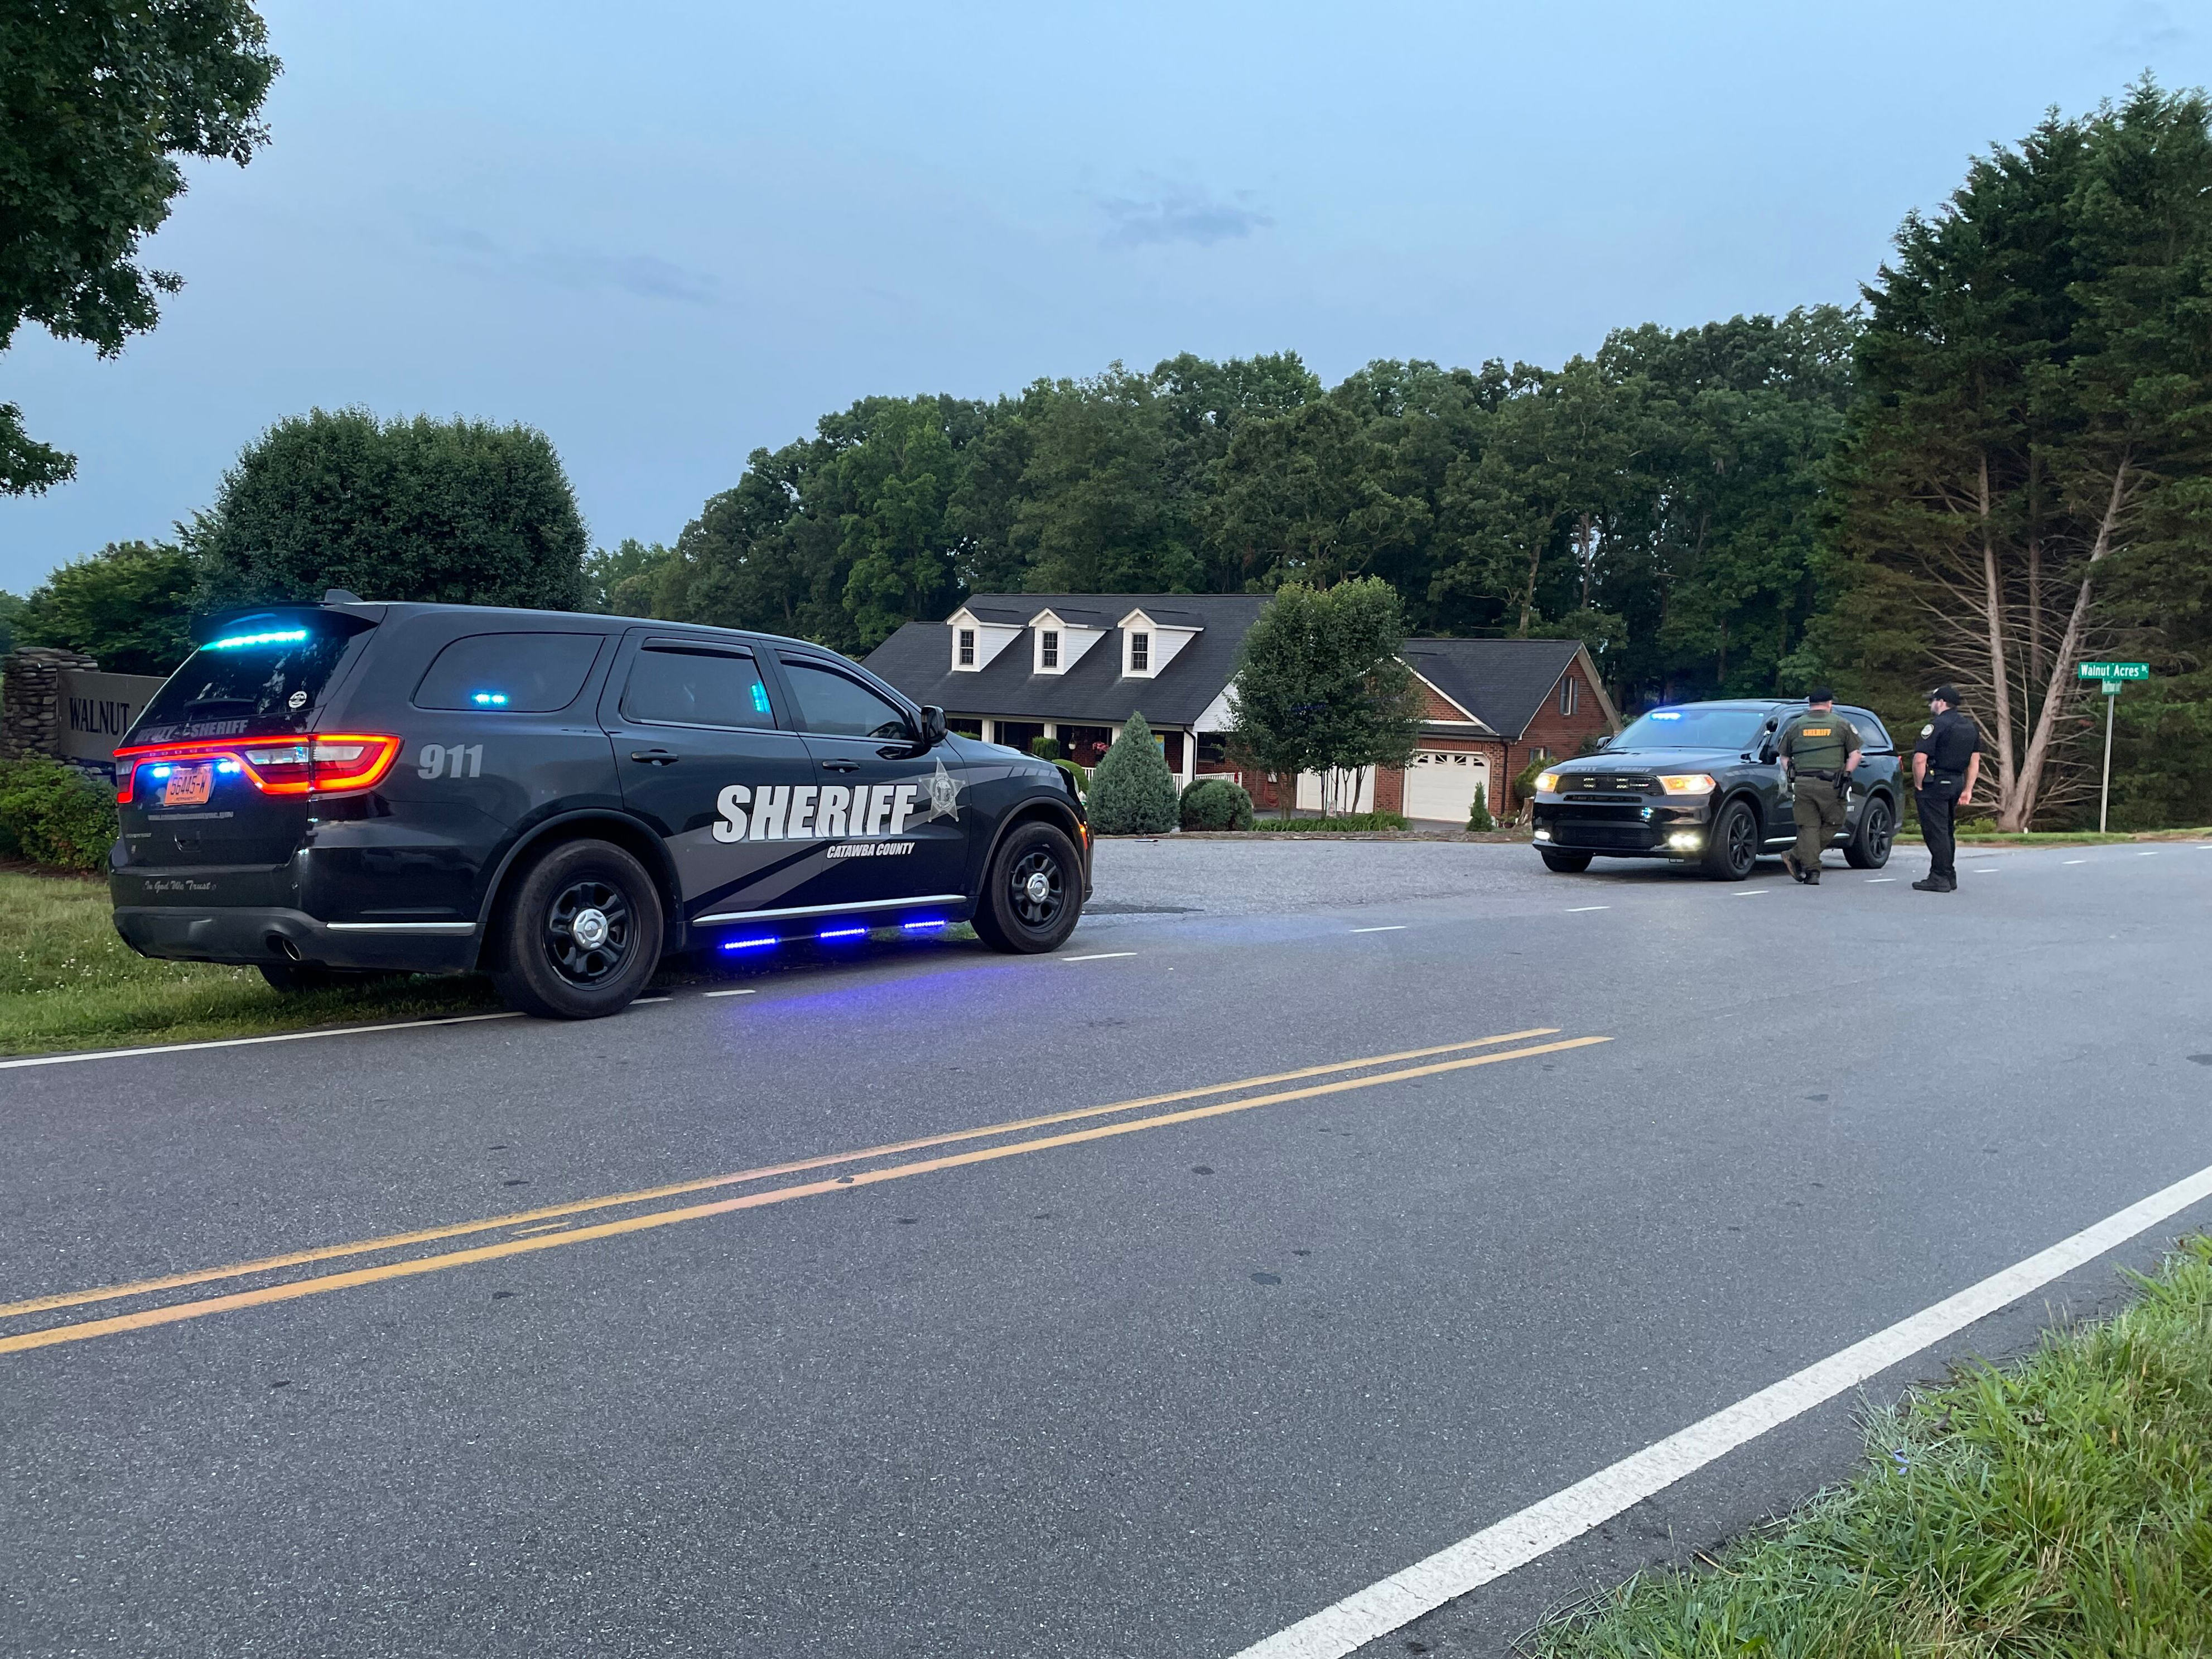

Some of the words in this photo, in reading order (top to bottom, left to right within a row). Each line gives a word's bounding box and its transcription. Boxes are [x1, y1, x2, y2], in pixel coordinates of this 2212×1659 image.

[2080, 664, 2109, 676] Walnut
[2113, 664, 2139, 677] Acres
[69, 697, 129, 737] WALNUT
[190, 719, 249, 737] SHERIFF
[417, 744, 483, 779] 911
[711, 784, 918, 843] SHERIFF
[826, 843, 874, 859] CATAWBA
[875, 842, 915, 856] COUNTY
[145, 880, 153, 890] In
[155, 880, 169, 894] God
[170, 880, 185, 890] We
[185, 880, 211, 891] Trust
